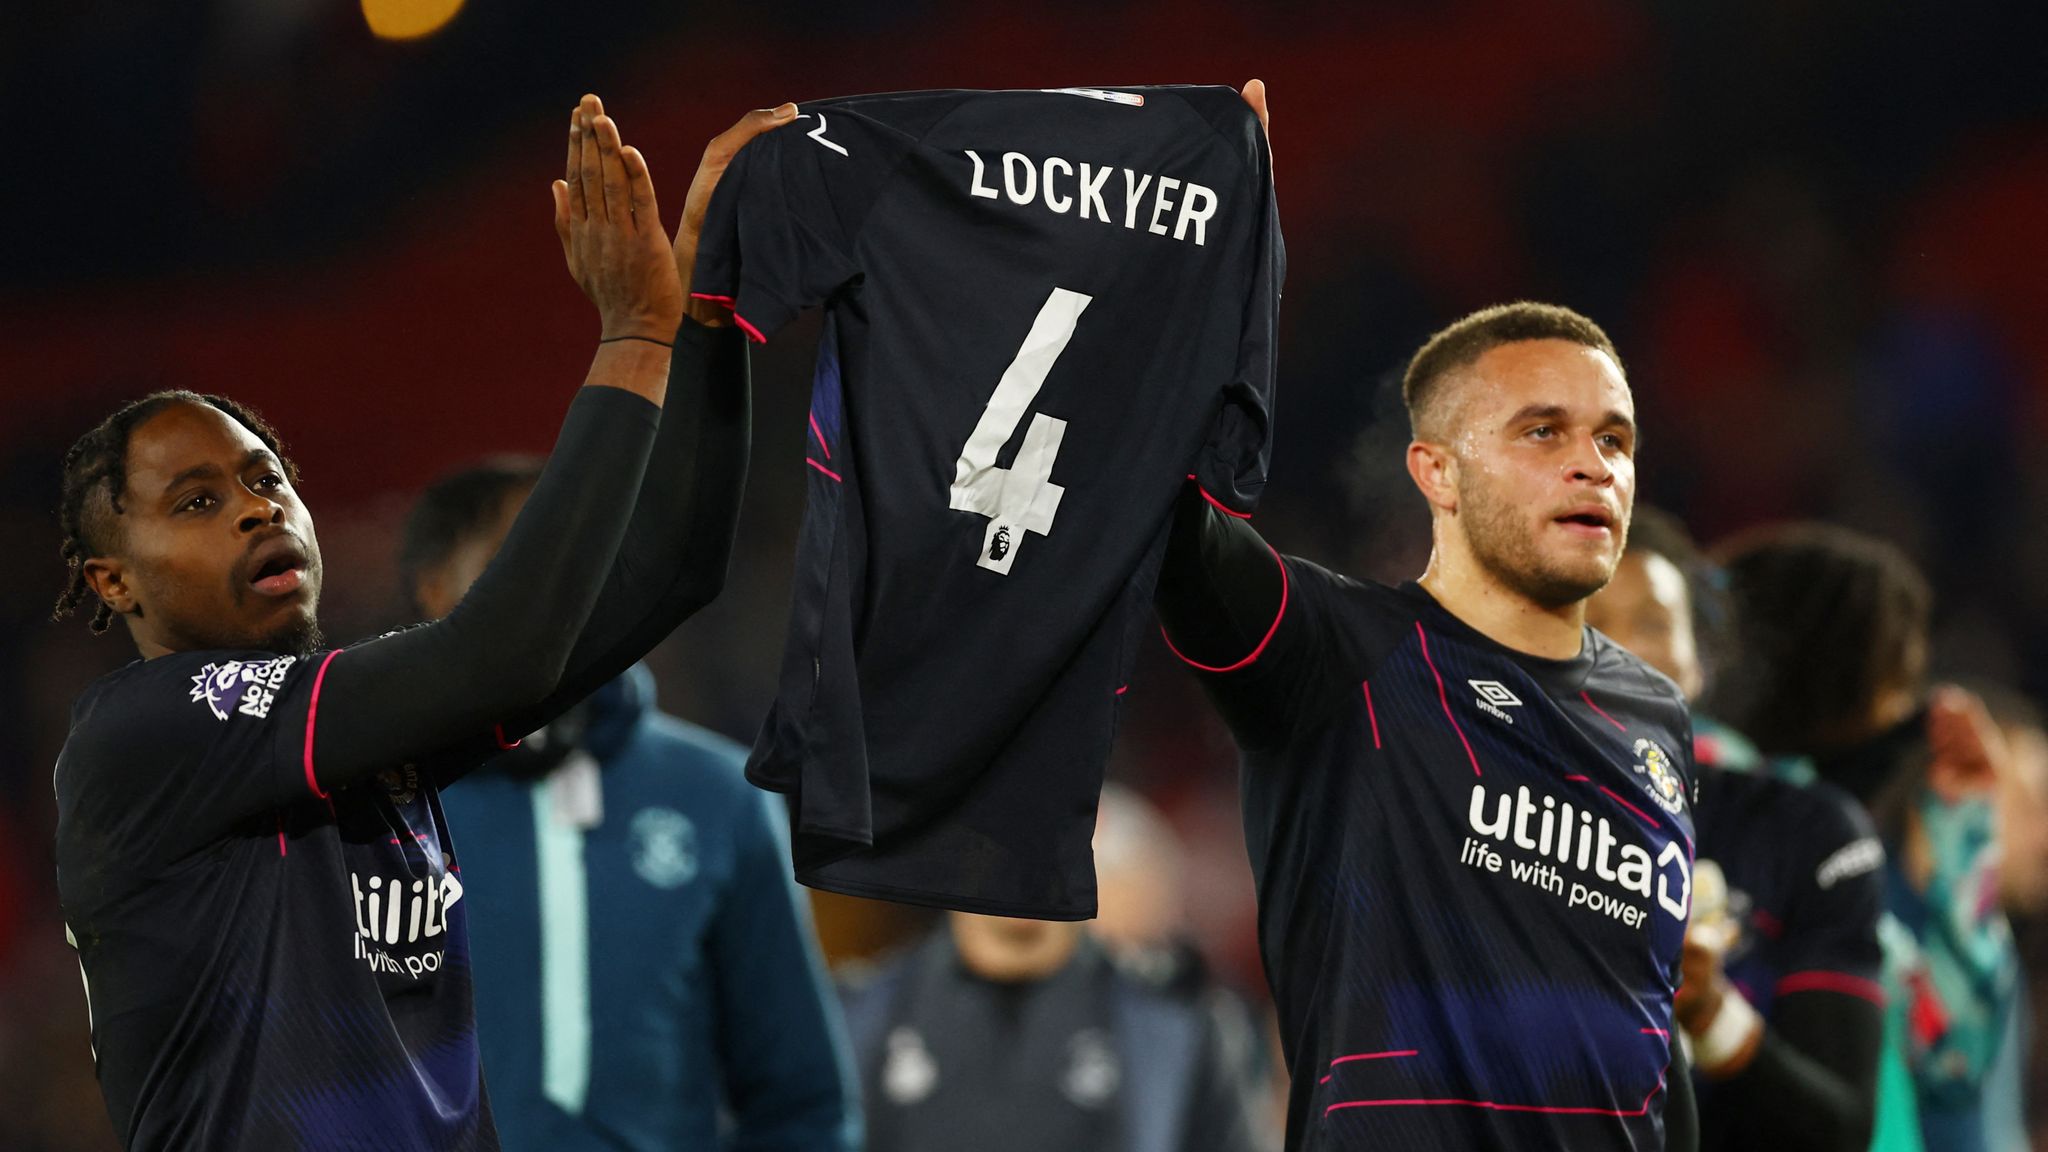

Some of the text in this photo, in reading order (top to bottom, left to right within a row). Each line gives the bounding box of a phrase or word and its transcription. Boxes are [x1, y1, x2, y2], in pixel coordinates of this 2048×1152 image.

[964, 150, 1218, 246] LOCKYER
[949, 286, 1093, 576] 4
[1475, 698, 1513, 724] umbro
[1460, 837, 1648, 929] life with power
[1468, 784, 1653, 898] utilita
[351, 872, 448, 945] tilit
